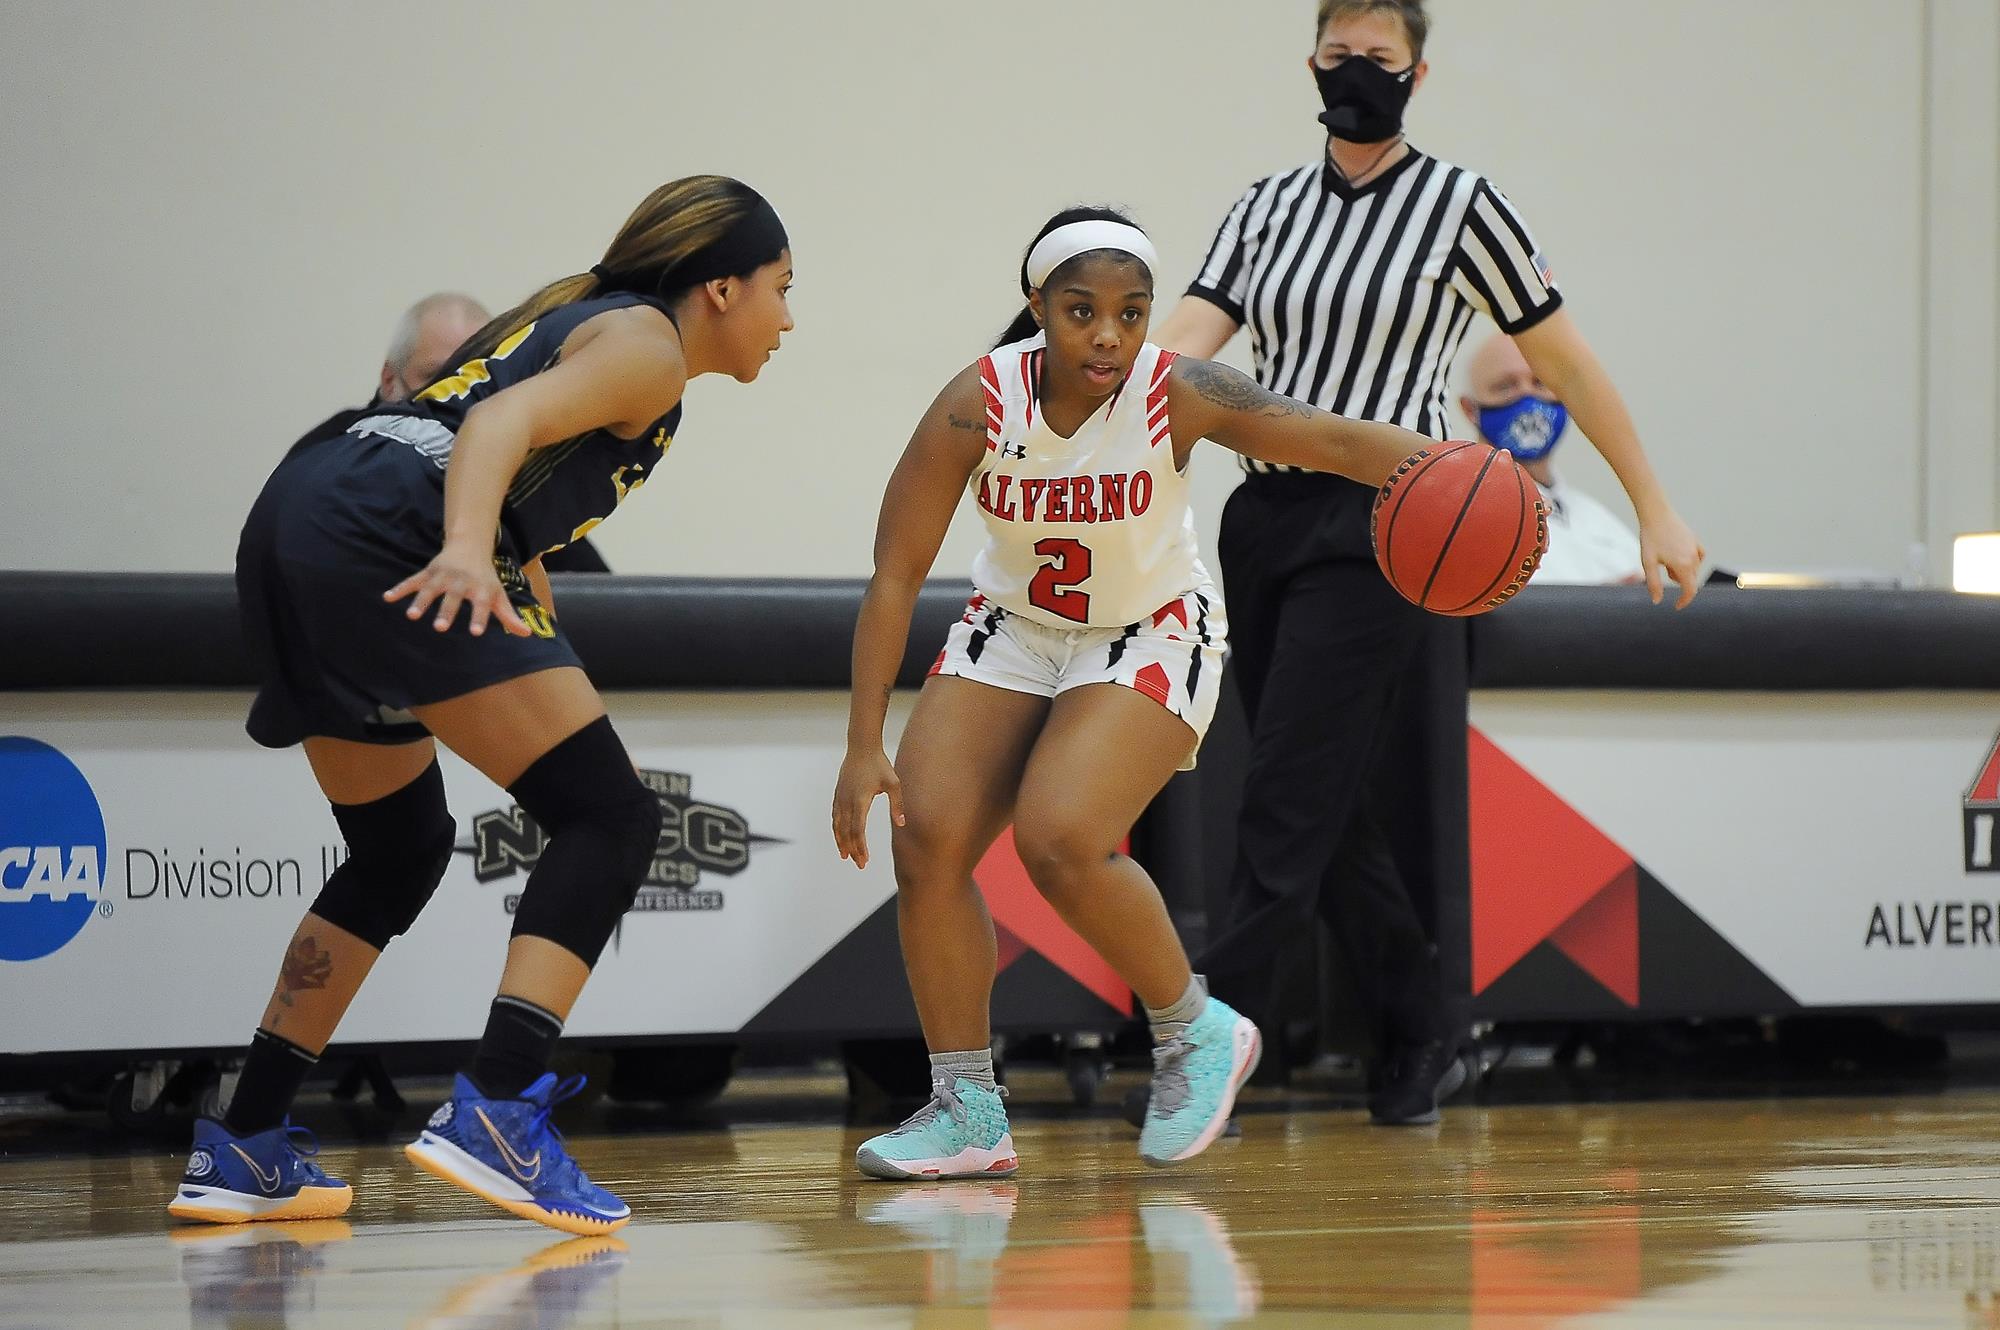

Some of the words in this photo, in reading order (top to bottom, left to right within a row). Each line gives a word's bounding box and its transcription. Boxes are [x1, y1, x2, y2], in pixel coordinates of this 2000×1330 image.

[1028, 537, 1092, 625] 2
[0, 846, 101, 902] CAA
[125, 847, 302, 899] Division
[473, 800, 749, 884] NC
[1865, 904, 2000, 946] ALVER
